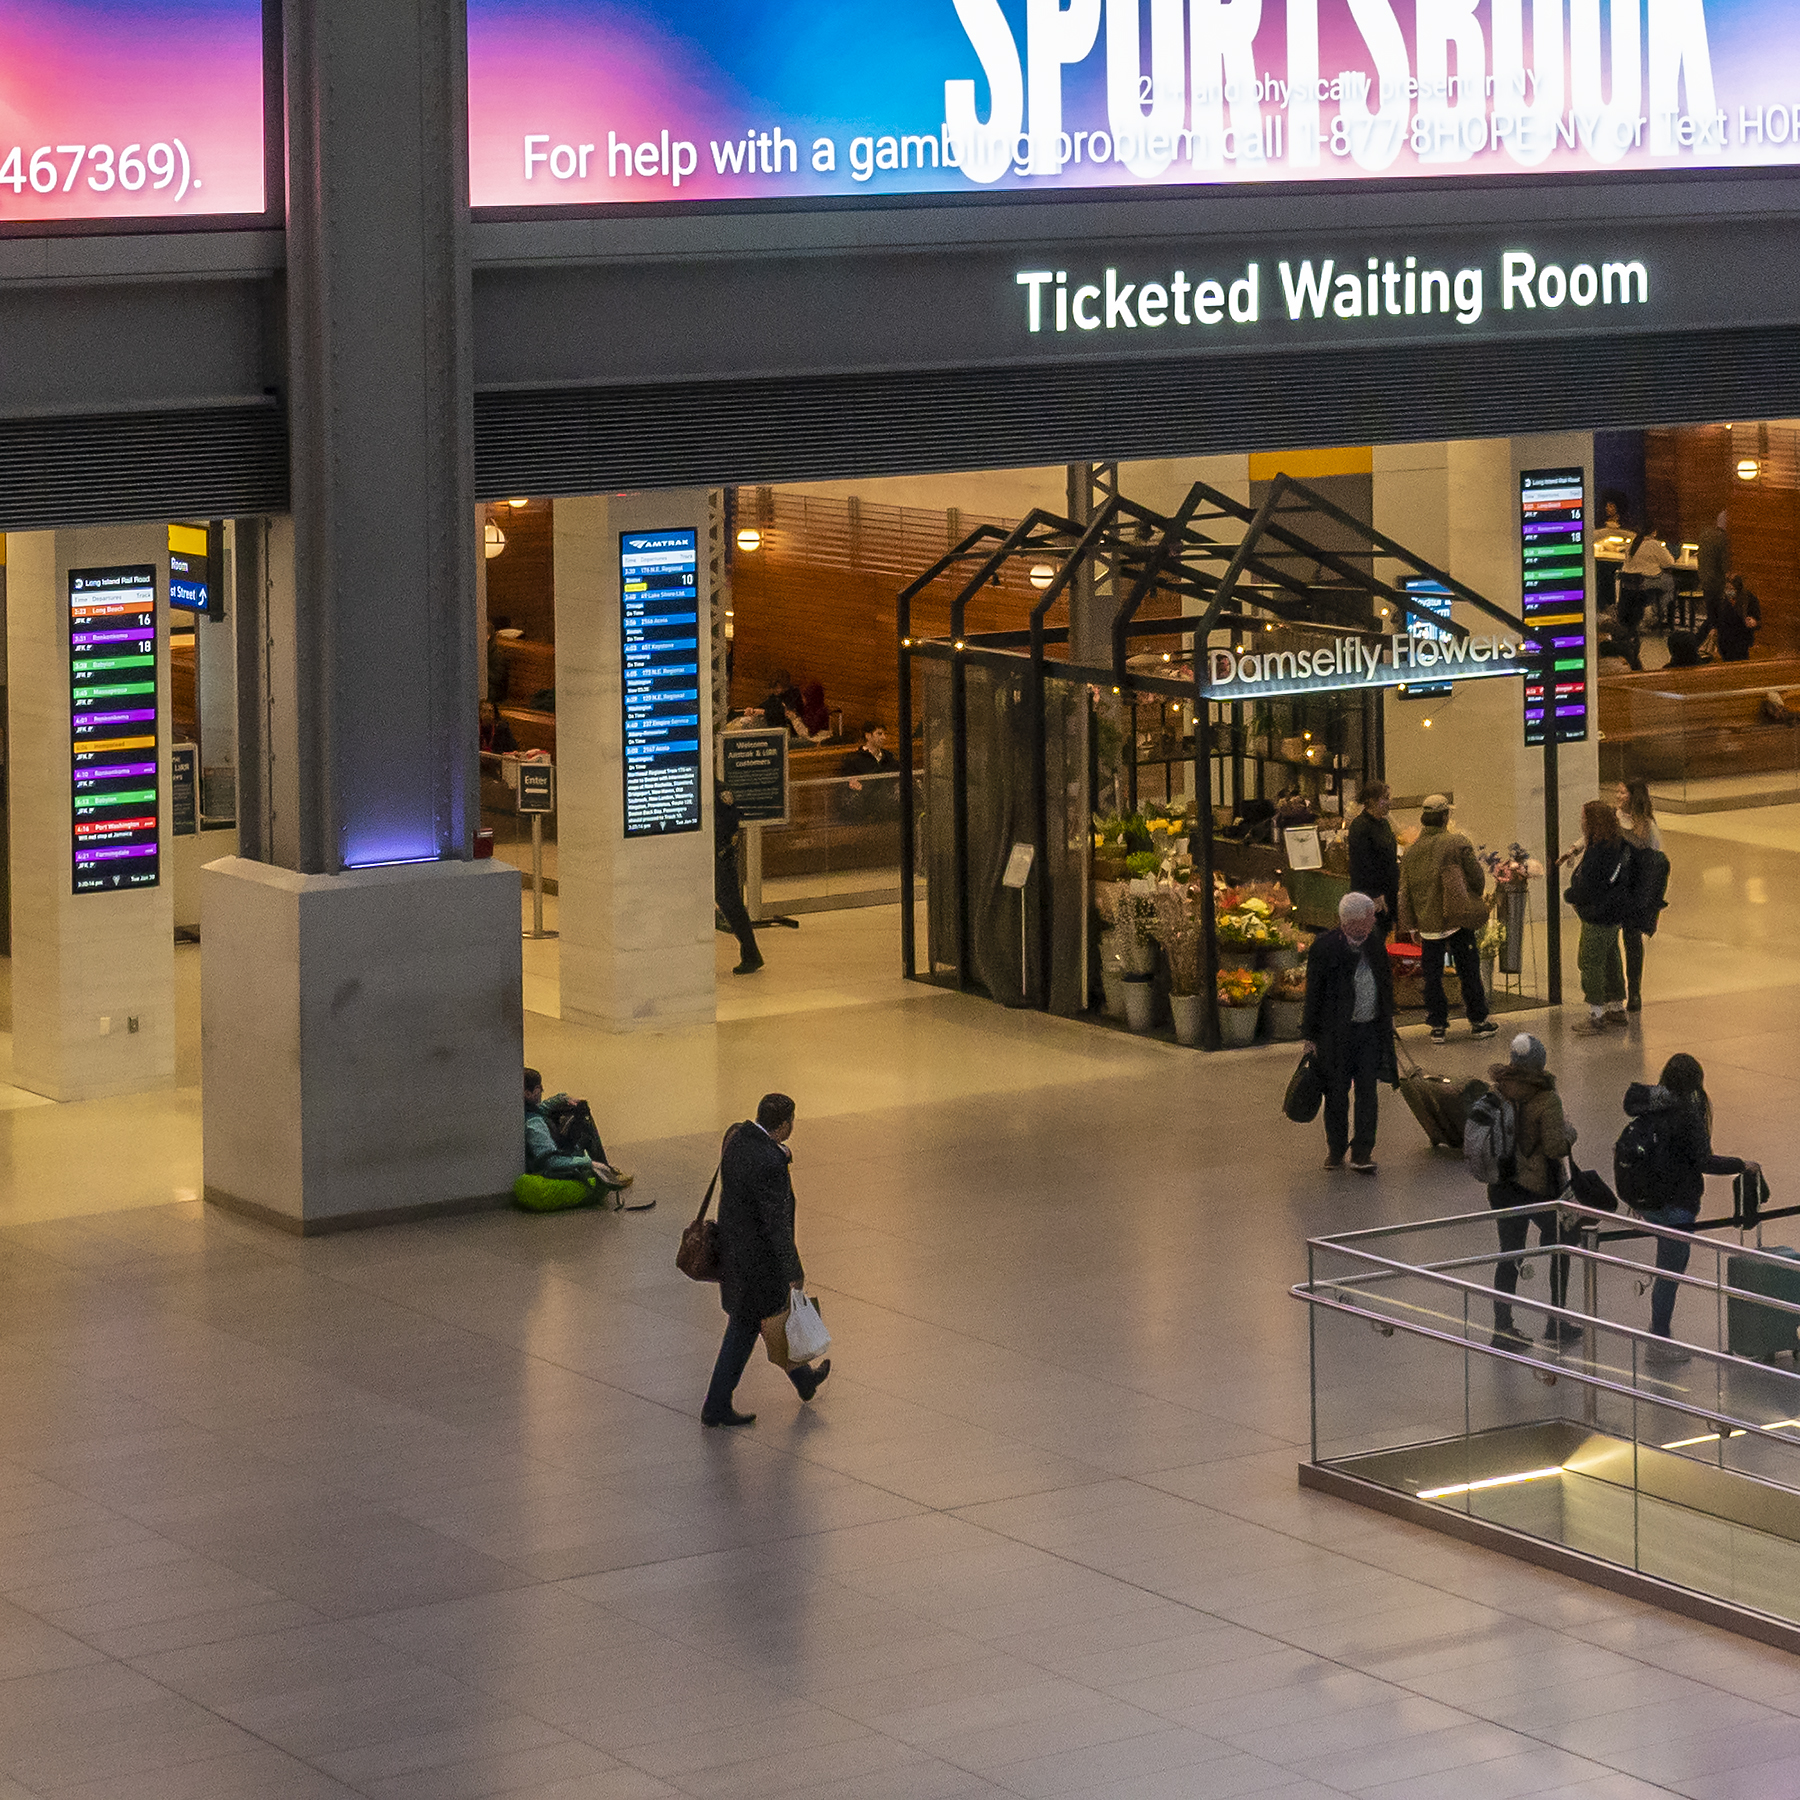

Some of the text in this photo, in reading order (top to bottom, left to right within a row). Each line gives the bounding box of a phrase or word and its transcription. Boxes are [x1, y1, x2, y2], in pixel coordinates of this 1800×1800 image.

[1249, 70, 1369, 108] physically
[523, 134, 593, 180] For
[608, 129, 697, 186] help
[709, 126, 797, 175] with
[810, 138, 838, 173] a
[849, 121, 1032, 181] gambling
[1054, 118, 1208, 174] problem
[1221, 114, 1283, 159] call
[1614, 114, 1647, 150] or
[1660, 108, 1728, 147] Text
[1017, 251, 1650, 332] Ticketed Waiting Room
[1570, 509, 1581, 519] 16
[644, 539, 689, 548] AMTRAK
[171, 556, 189, 573] Room
[85, 579, 101, 587] Long
[134, 575, 150, 583] Road
[682, 574, 694, 585] 10
[177, 585, 196, 601] Street
[138, 614, 151, 625] 16
[138, 641, 152, 653] 18
[1210, 632, 1517, 686] Damselfly Flowers
[524, 775, 548, 785] Enter
